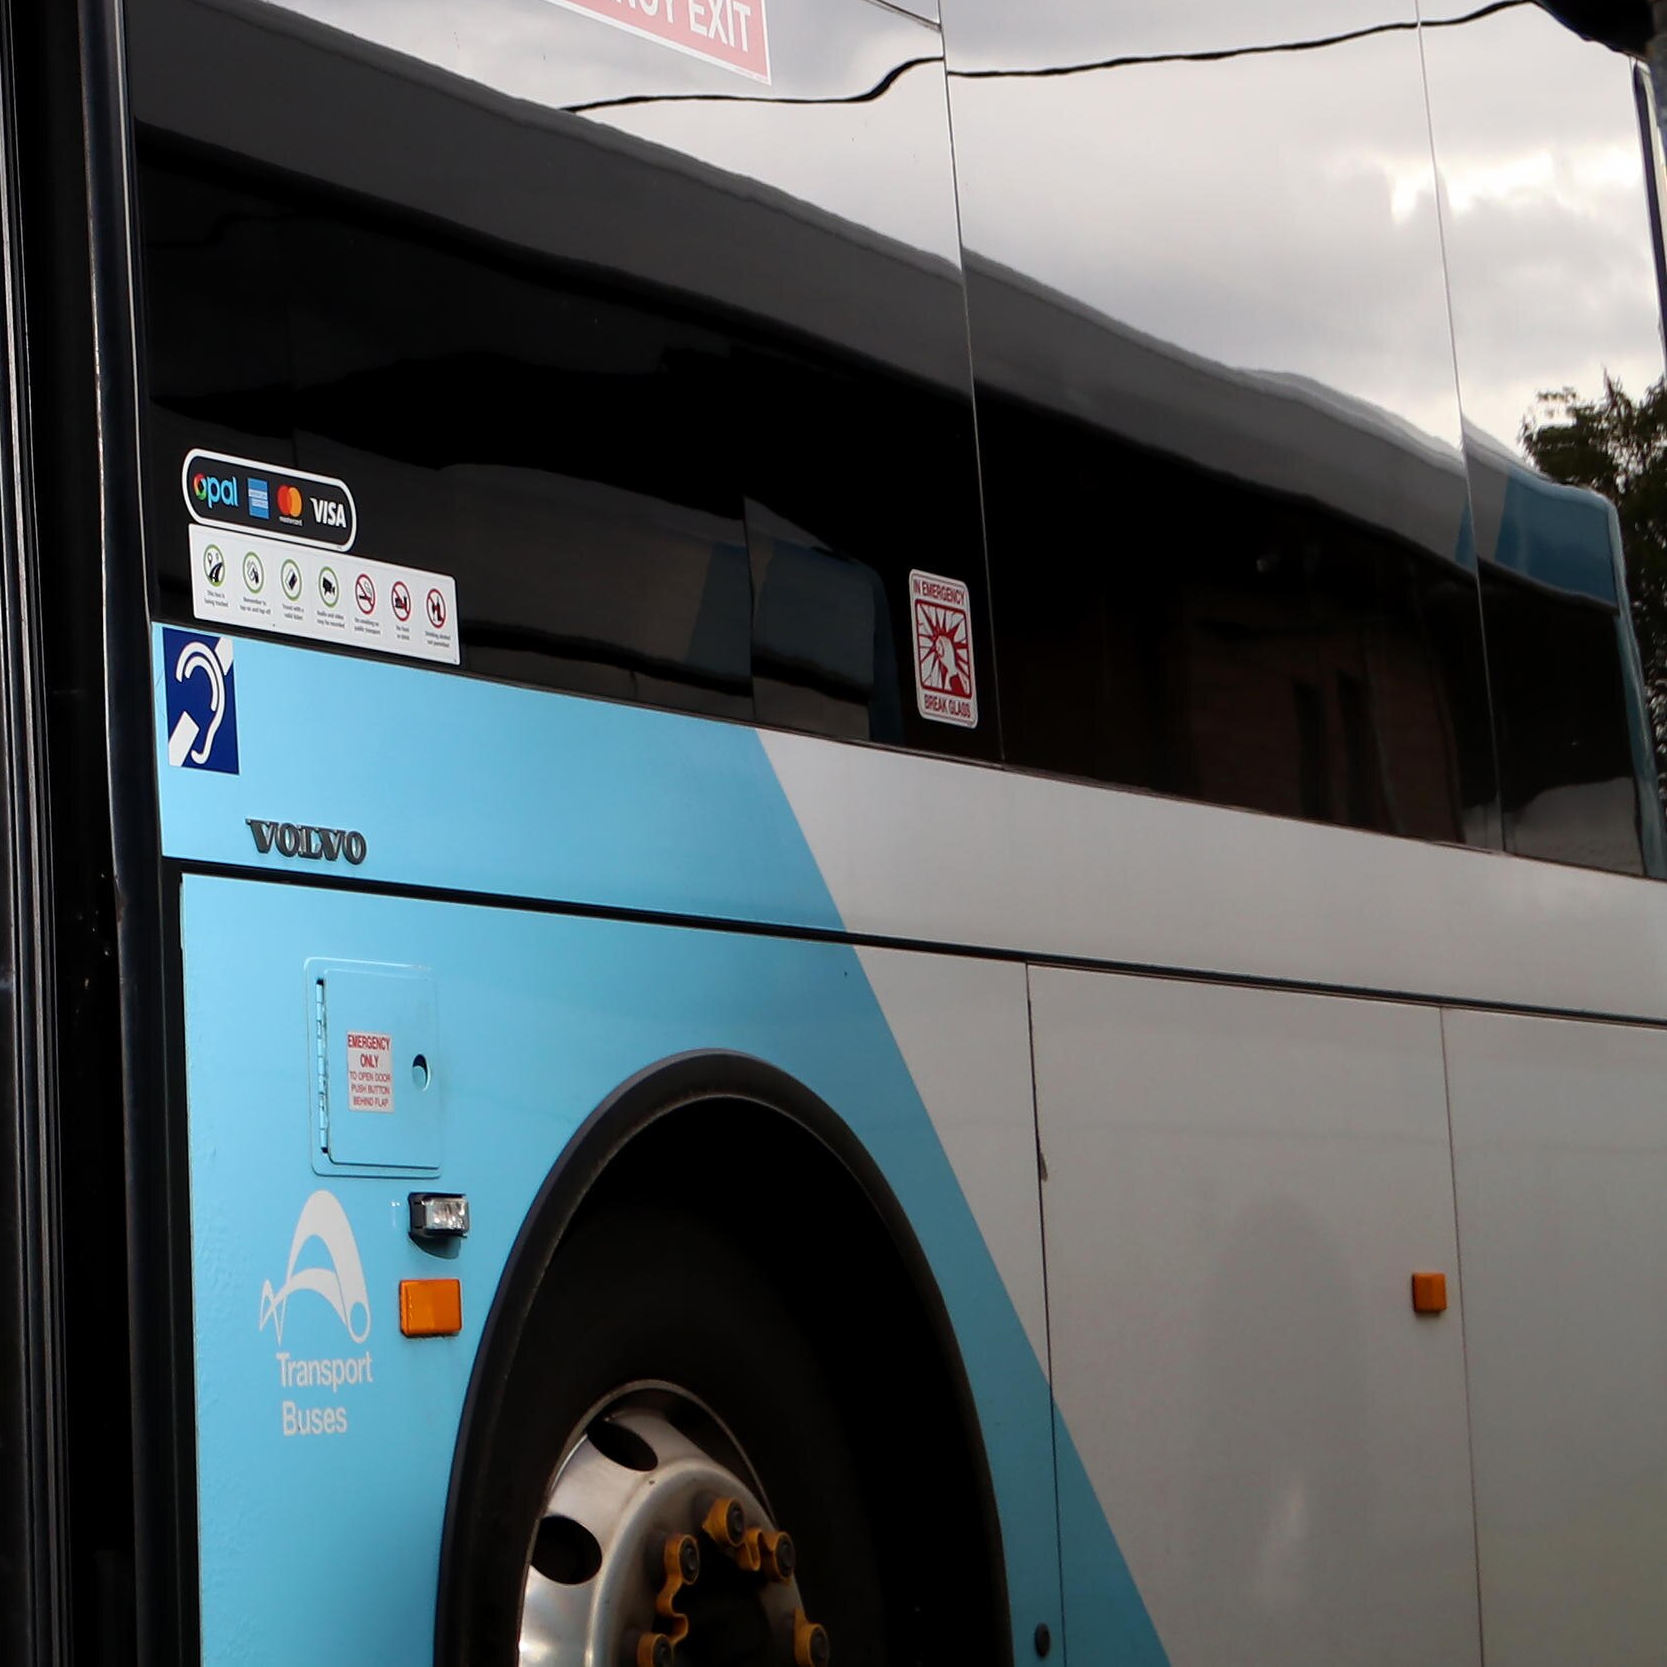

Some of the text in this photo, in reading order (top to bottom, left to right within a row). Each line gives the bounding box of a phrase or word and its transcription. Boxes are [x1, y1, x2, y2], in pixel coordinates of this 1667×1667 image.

[193, 472, 239, 508] opal
[309, 497, 347, 528] VISA
[922, 581, 965, 605] EMERGENCY
[924, 694, 971, 718] BREAK GLASS
[245, 818, 367, 866] VOLVO
[347, 1035, 391, 1050] EMERGENCY
[360, 1053, 379, 1068] ONLY
[275, 1350, 374, 1394] Transport
[282, 1399, 348, 1436] Buses
